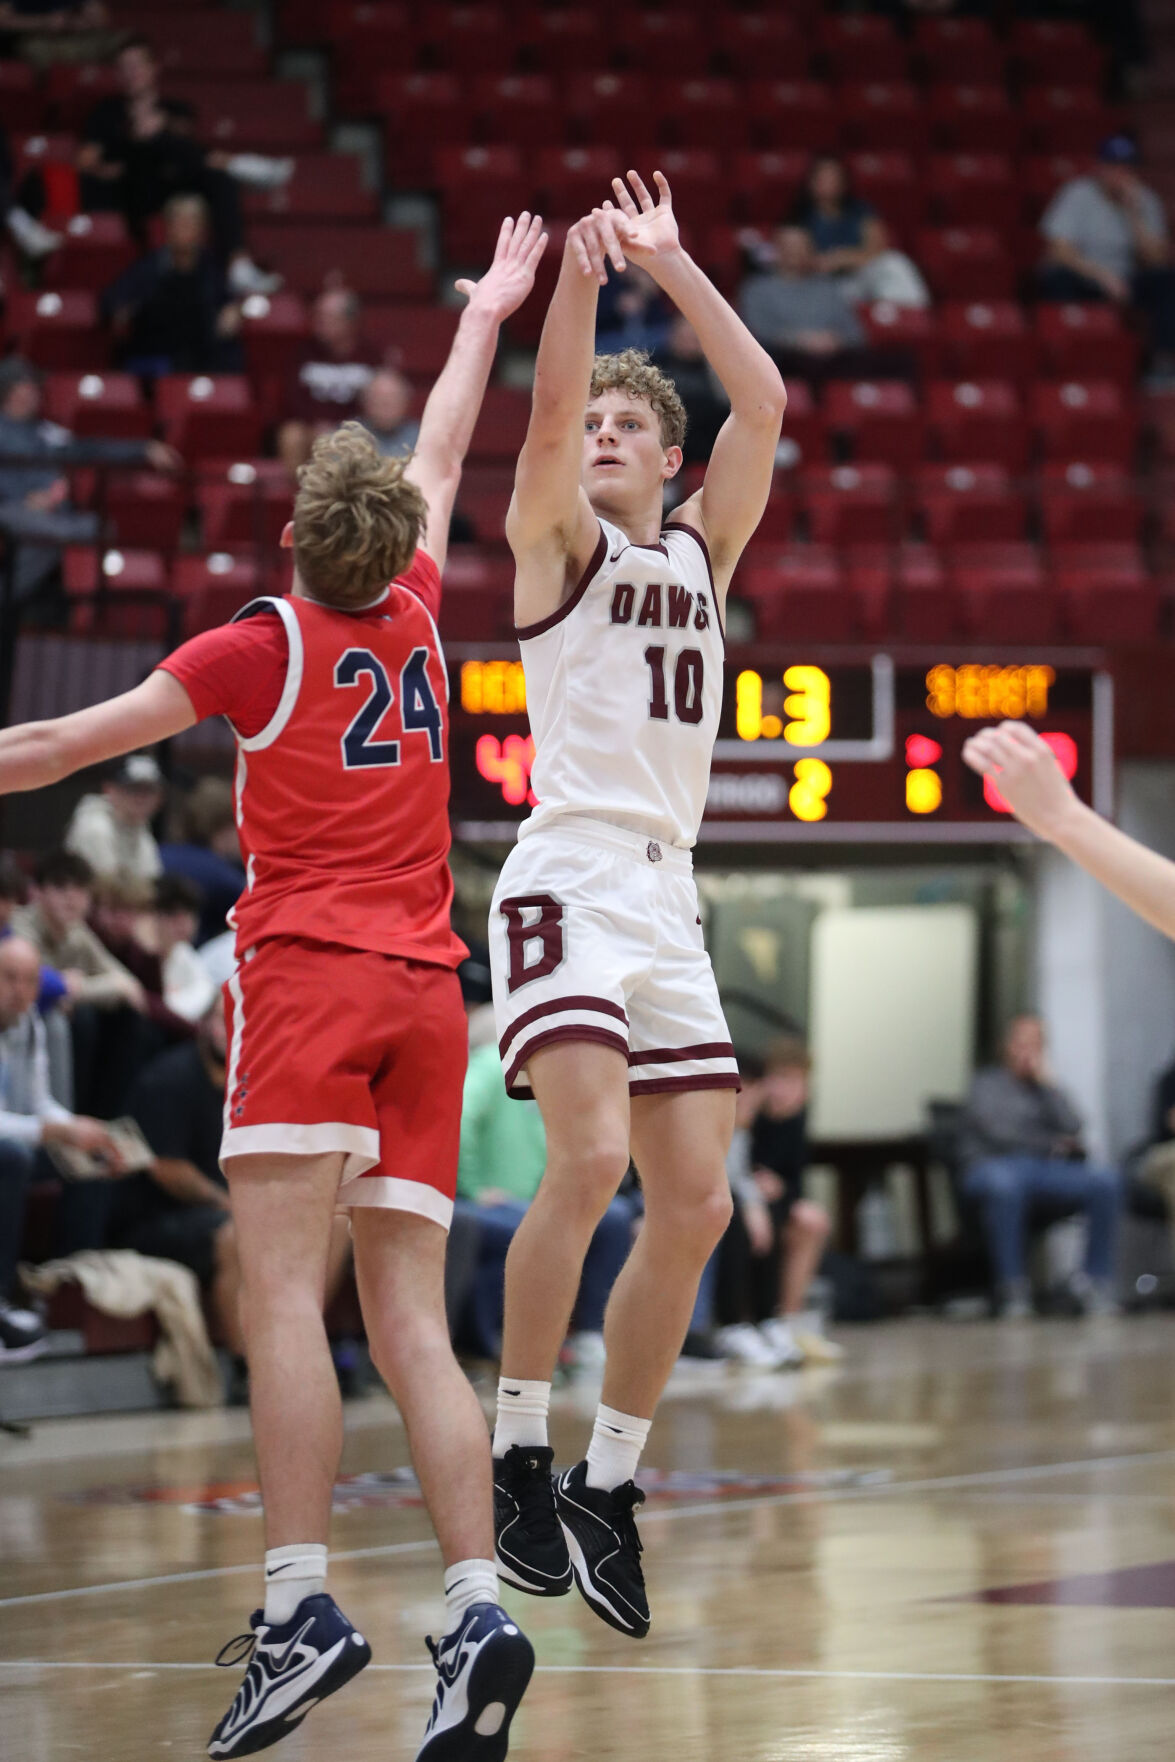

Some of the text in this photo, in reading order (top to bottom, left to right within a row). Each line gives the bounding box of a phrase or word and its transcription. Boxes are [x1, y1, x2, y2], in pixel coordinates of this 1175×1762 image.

[610, 581, 710, 631] DAWS
[333, 646, 444, 770] 24
[643, 643, 705, 727] 10
[500, 889, 568, 1000] B
